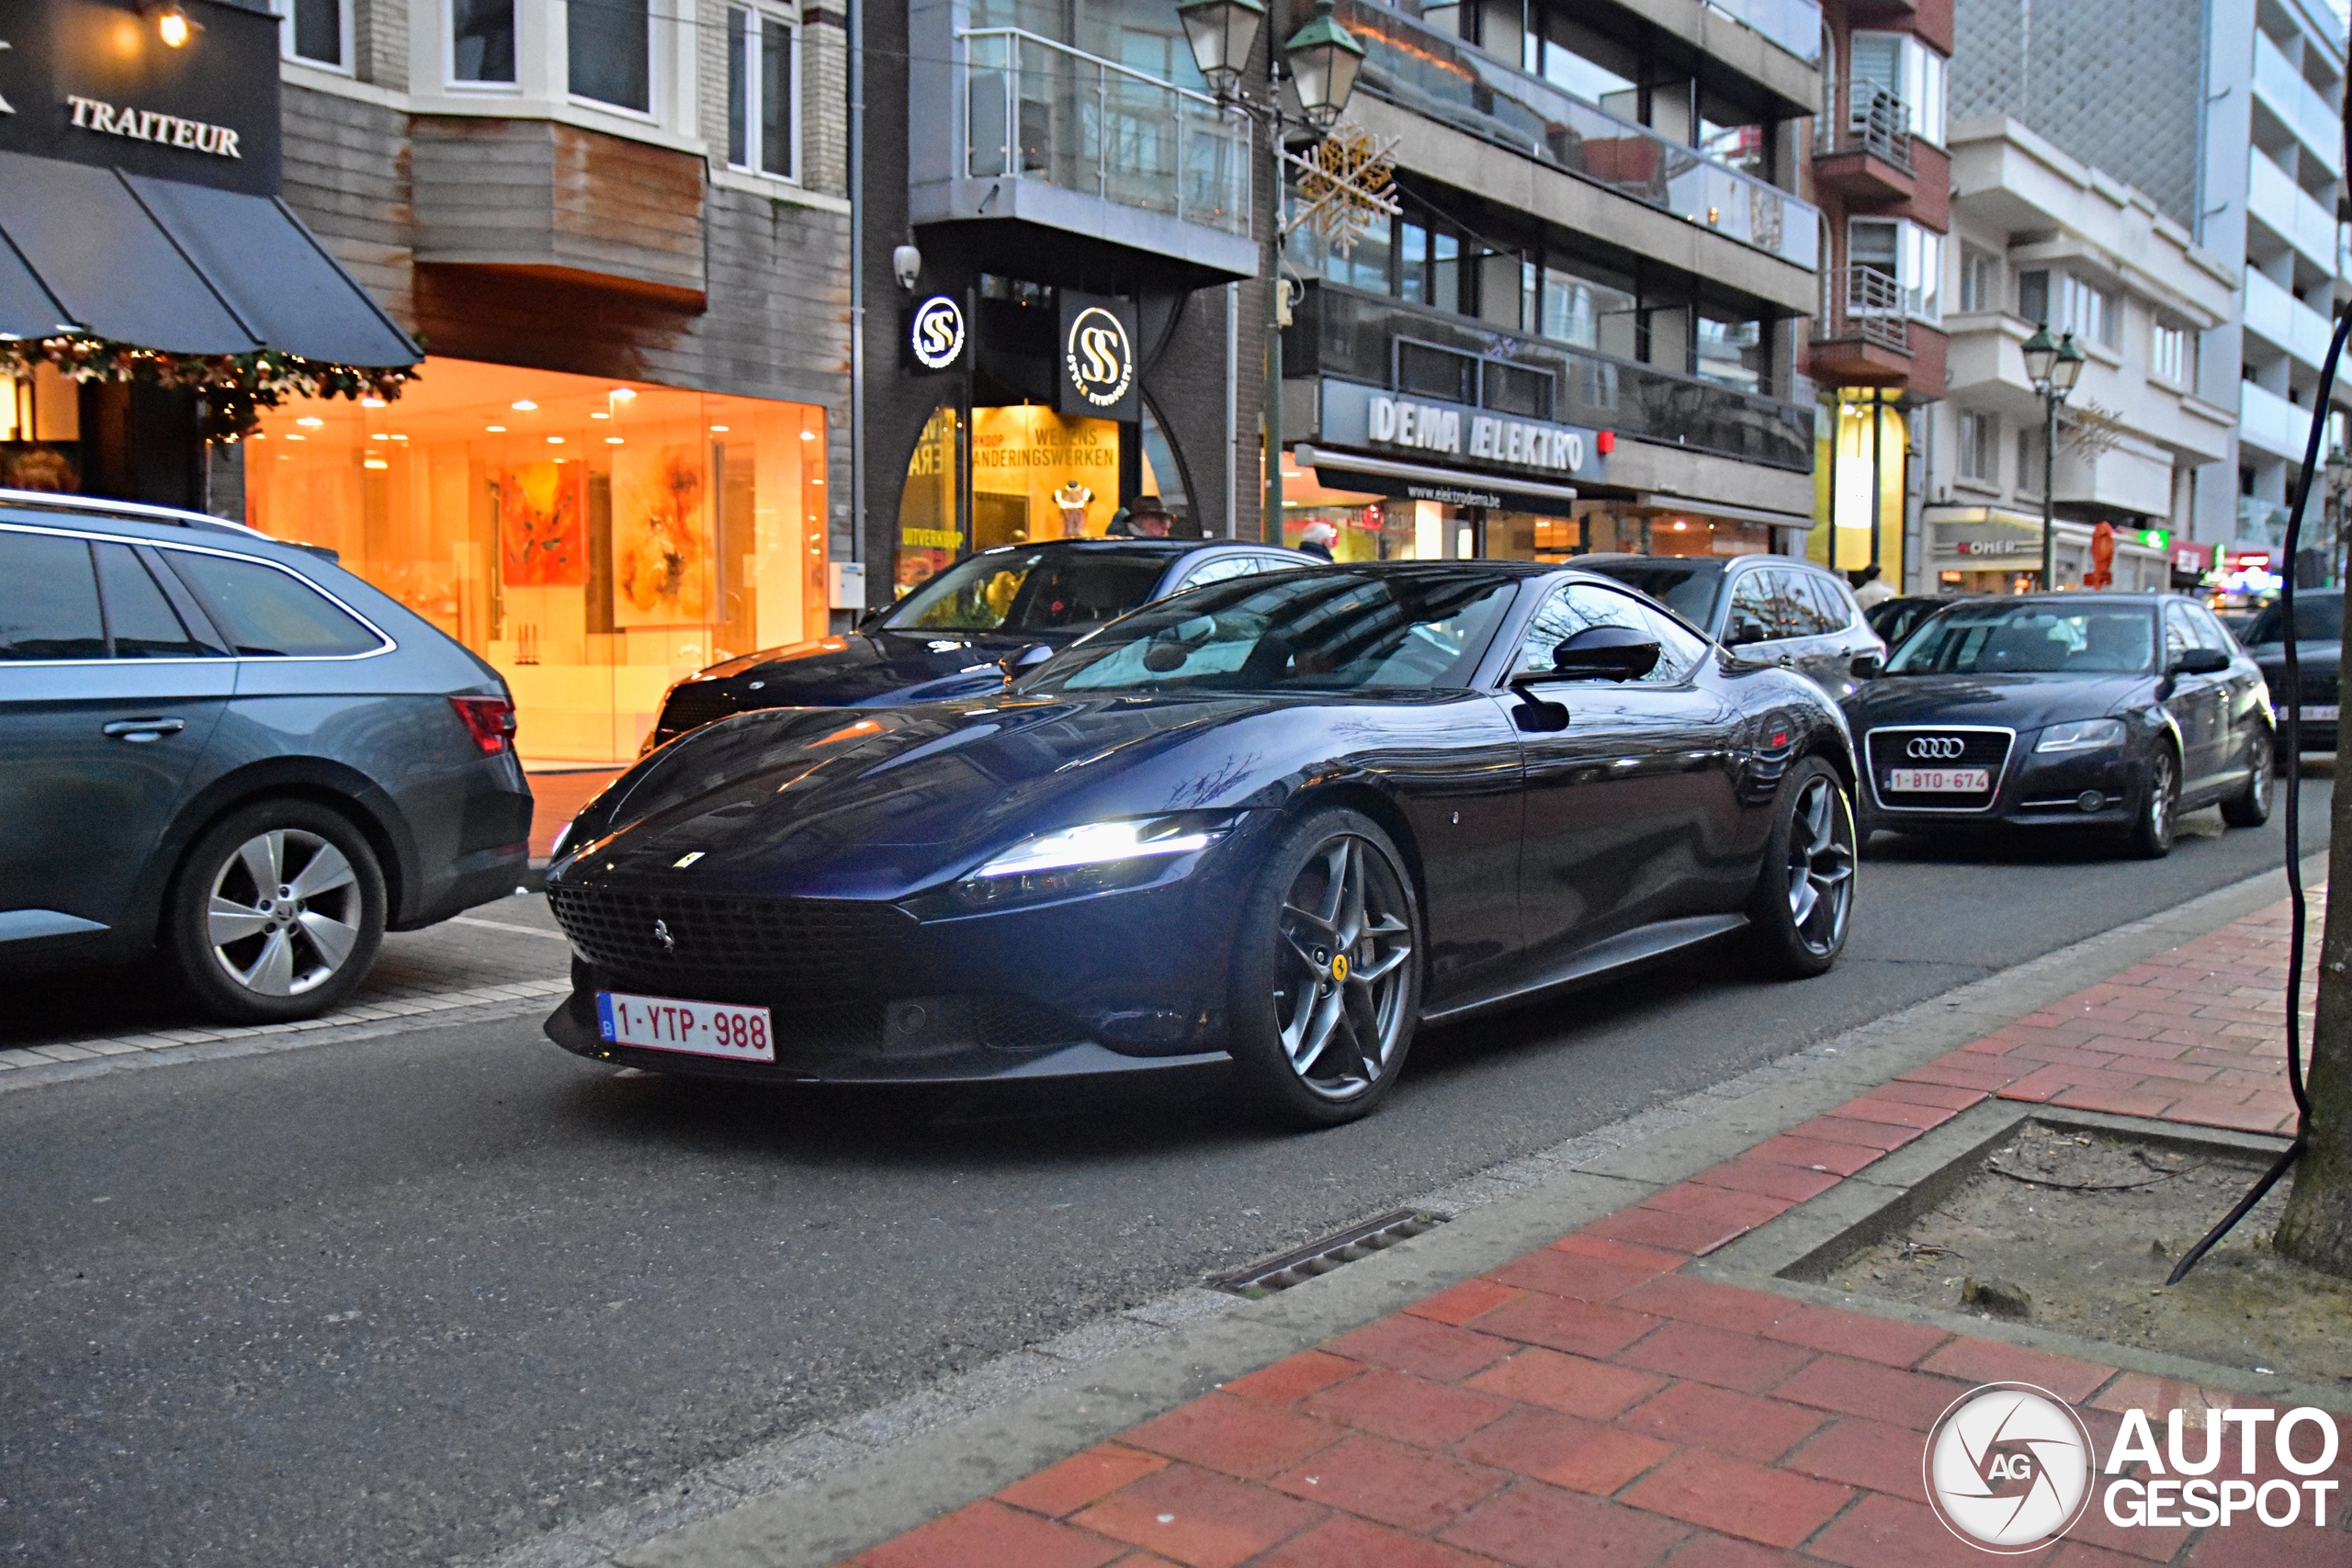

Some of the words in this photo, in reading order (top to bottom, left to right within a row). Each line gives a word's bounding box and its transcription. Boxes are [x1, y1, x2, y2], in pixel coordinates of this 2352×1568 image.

[67, 94, 242, 159] TRAITEUR
[1368, 396, 1461, 455] DEMA
[1469, 415, 1584, 472] ELEKTRO
[1408, 485, 1501, 510] www.elektrodema.be
[1894, 773, 1984, 788] 1-BTO-674
[603, 1021, 614, 1037] B
[618, 1002, 767, 1050] 1-YTP-988
